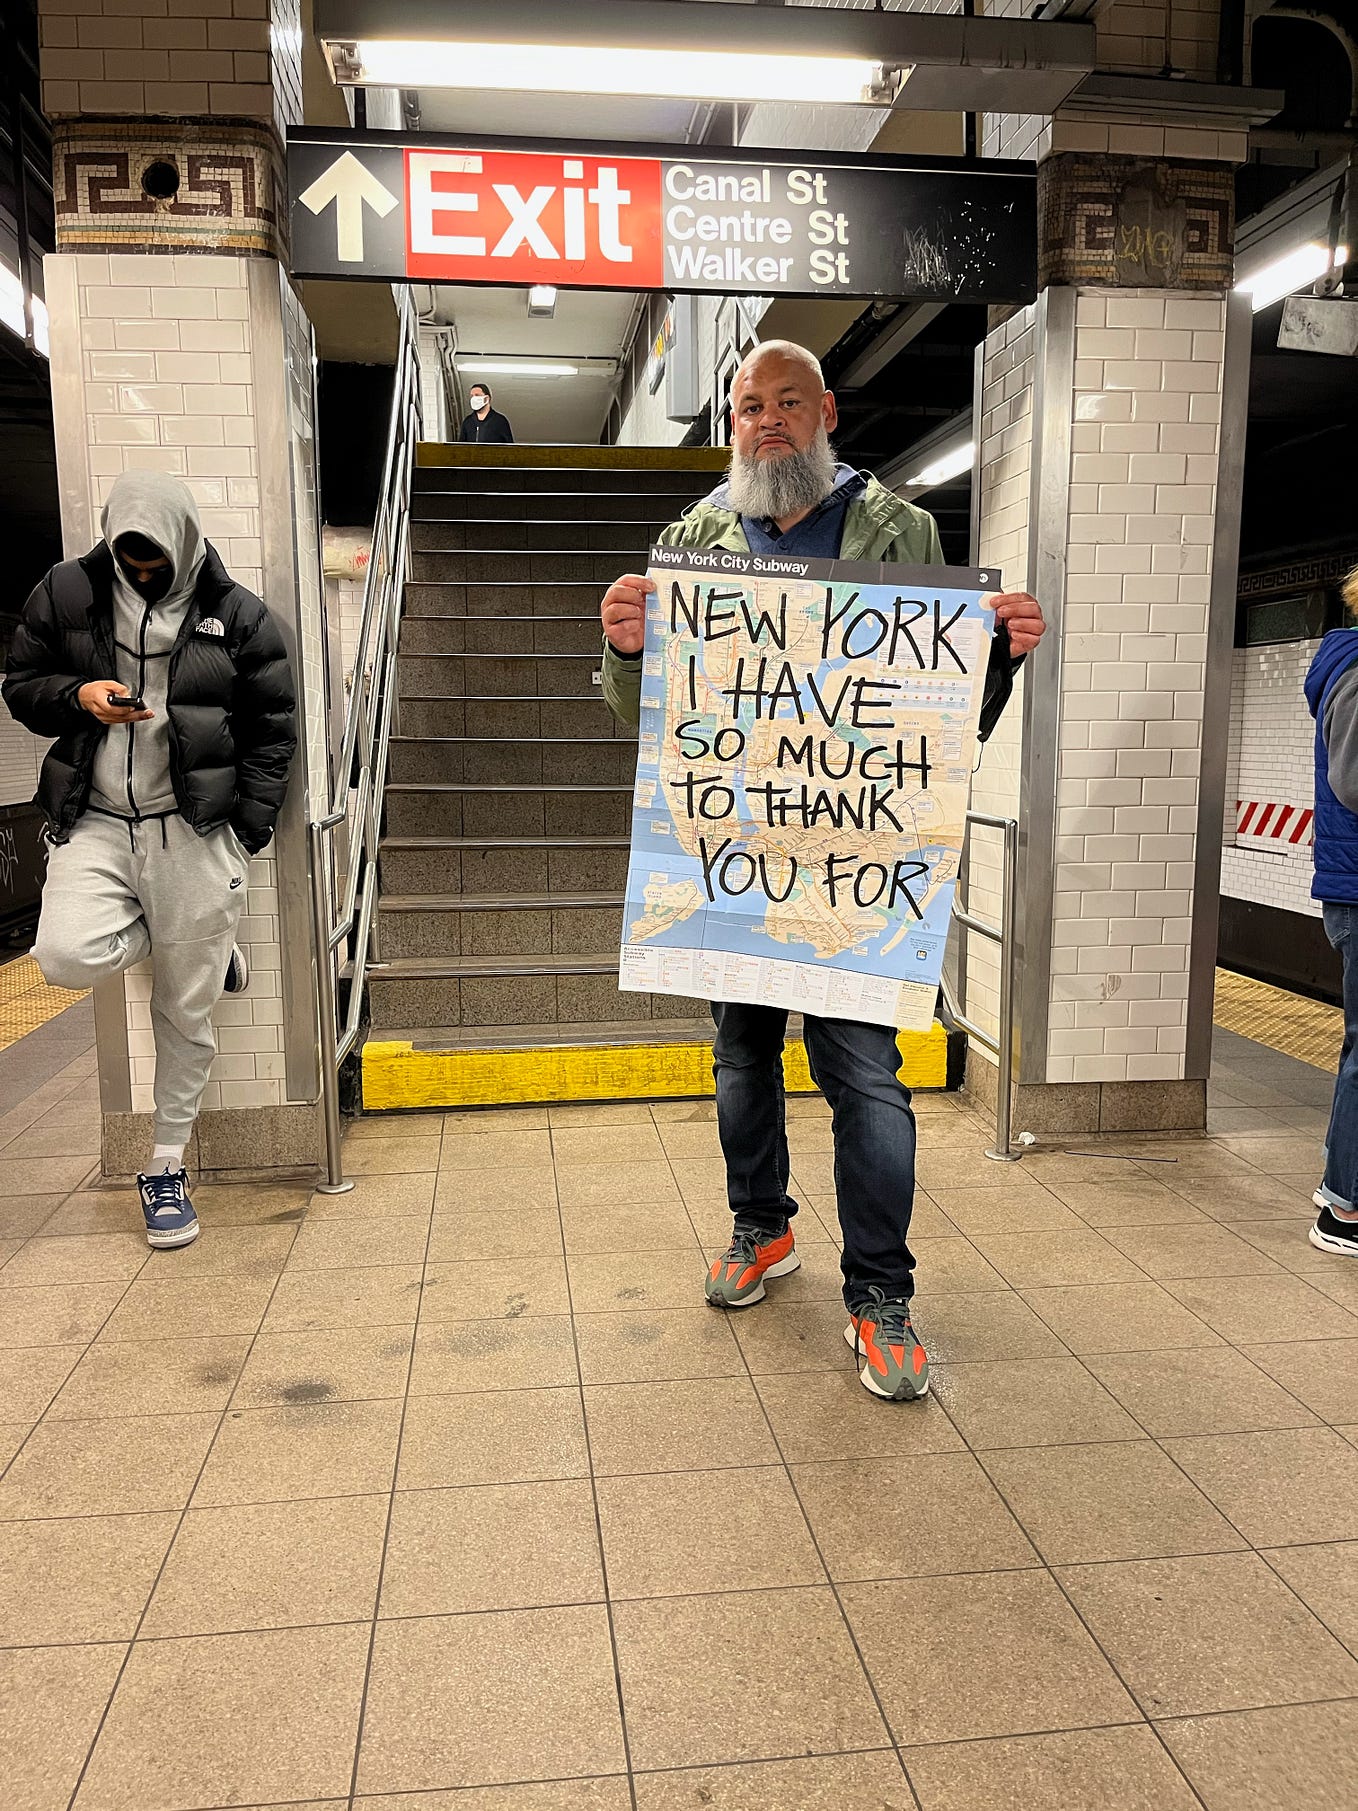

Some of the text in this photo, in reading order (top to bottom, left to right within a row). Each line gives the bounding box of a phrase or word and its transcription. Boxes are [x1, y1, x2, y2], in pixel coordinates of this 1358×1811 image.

[408, 152, 633, 262] Exit
[665, 165, 827, 205] Canal St
[666, 205, 849, 245] Centre St
[667, 245, 850, 284] Walker St
[651, 548, 809, 577] New York City Subway
[671, 581, 787, 650] NEW
[821, 587, 968, 674] YORK
[688, 654, 902, 728] I HAVE
[674, 720, 746, 762] SO
[777, 735, 932, 790] MUCH
[670, 771, 904, 833] TO THANK
[699, 837, 930, 921] YOU FOR
